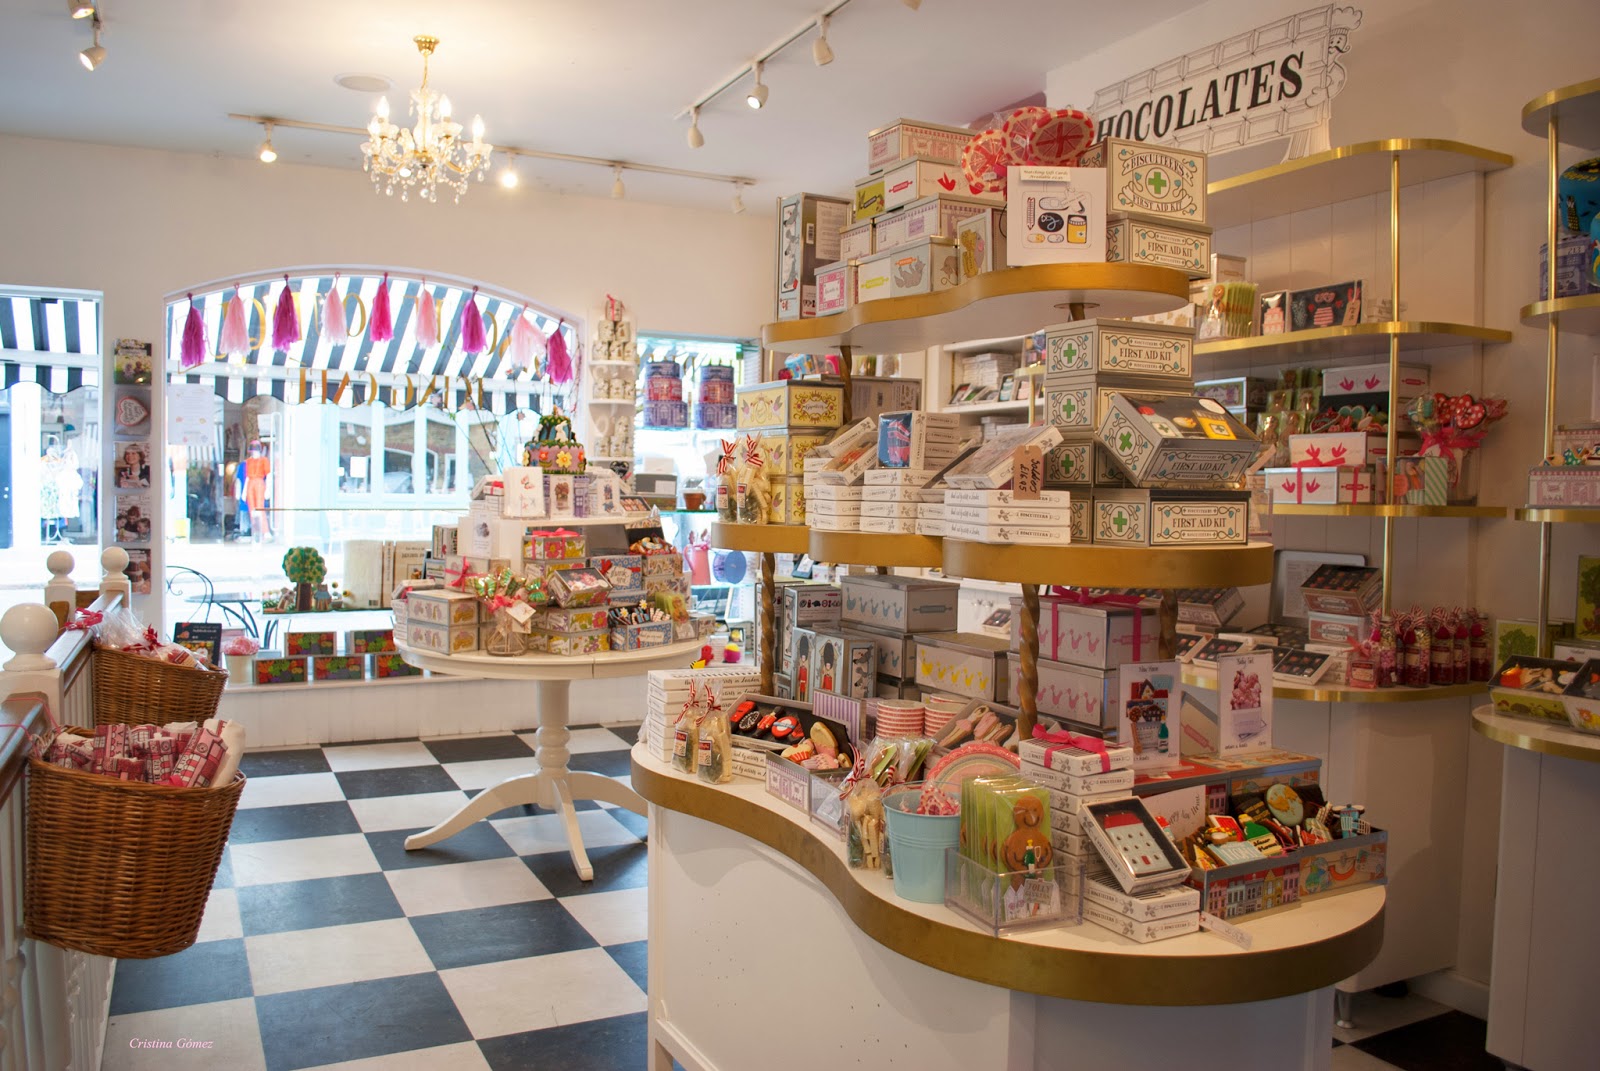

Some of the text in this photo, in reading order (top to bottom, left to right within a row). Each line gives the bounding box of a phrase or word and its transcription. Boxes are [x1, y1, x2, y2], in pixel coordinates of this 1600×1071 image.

[1096, 52, 1304, 142] HOCOLATES
[1130, 153, 1185, 176] BISCUITEERS
[1132, 194, 1183, 212] FIRST AID KIT
[1148, 241, 1193, 258] FIRST AID KIT
[1120, 348, 1172, 361] FIRST AID KIT
[1171, 462, 1228, 471] FIRST AID KIT
[1029, 459, 1040, 493] Soldiers
[1172, 518, 1227, 528] FIRST AID KIT
